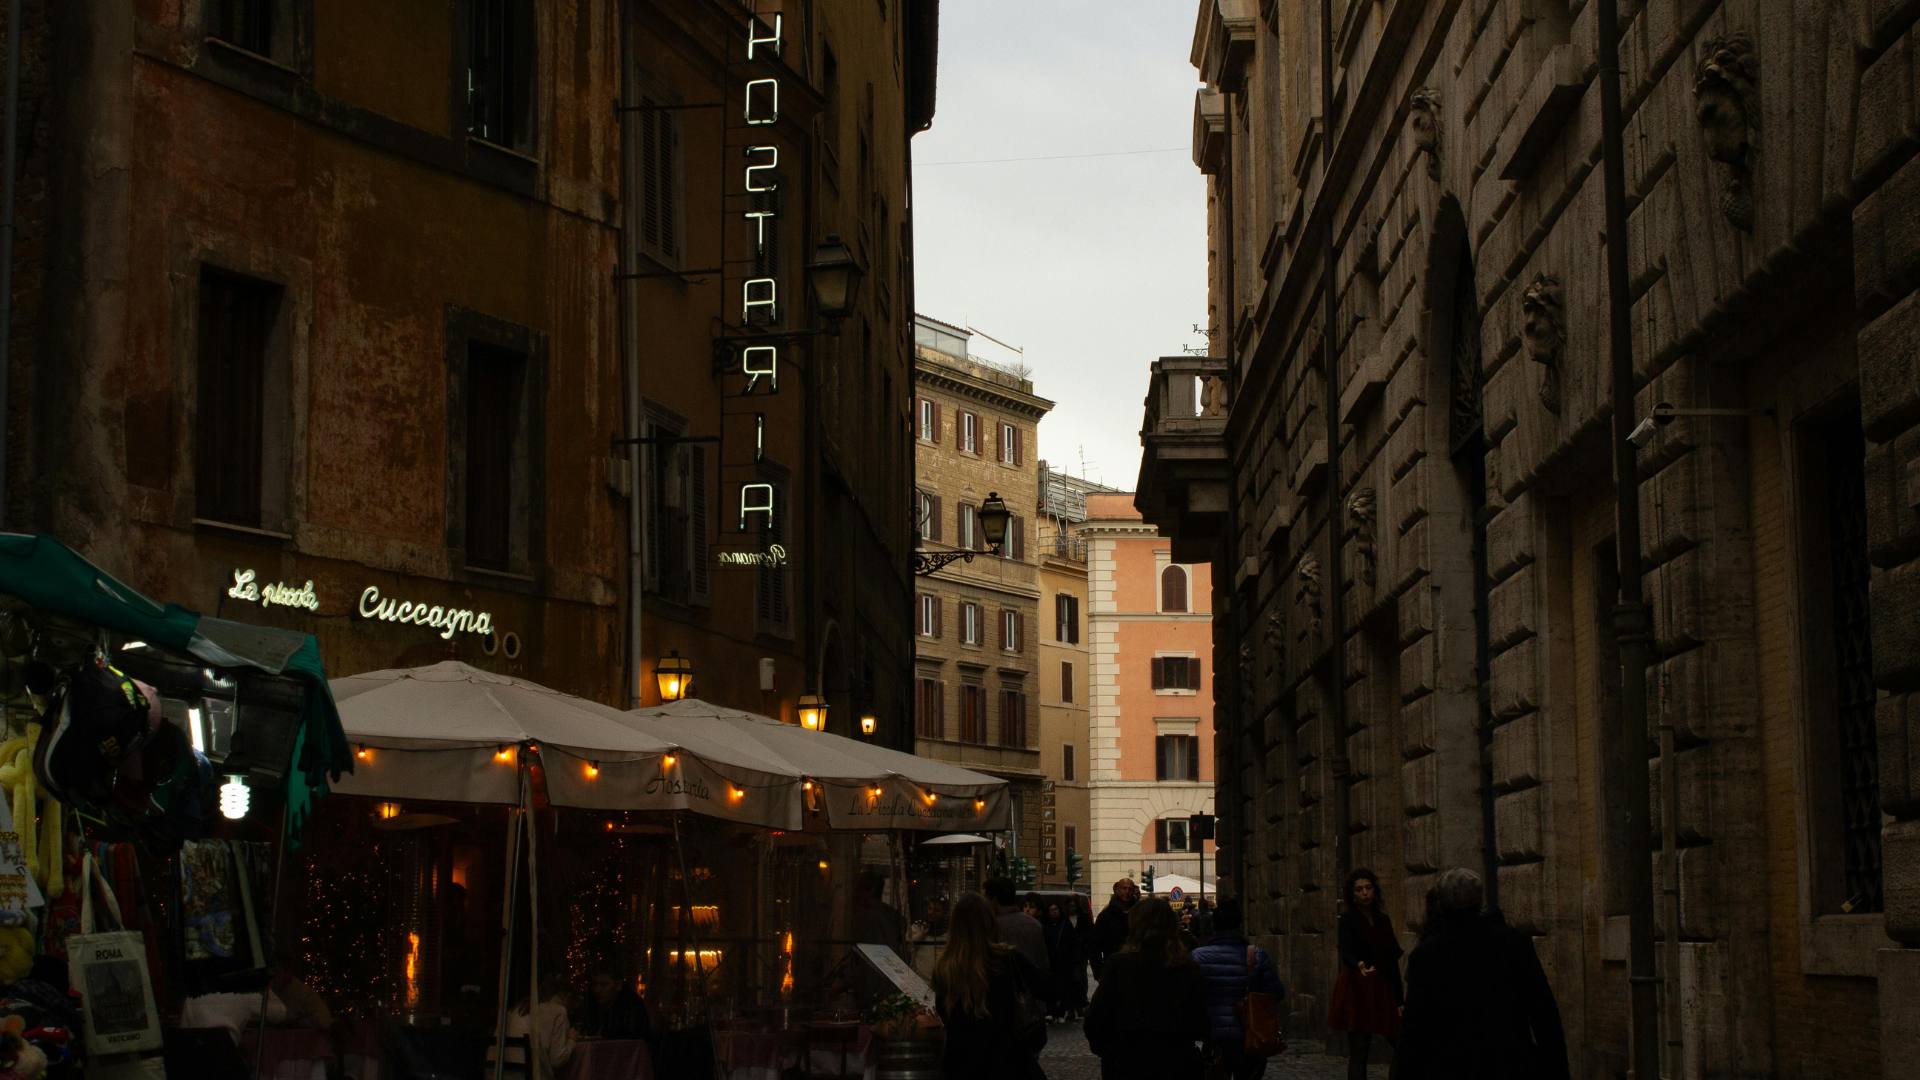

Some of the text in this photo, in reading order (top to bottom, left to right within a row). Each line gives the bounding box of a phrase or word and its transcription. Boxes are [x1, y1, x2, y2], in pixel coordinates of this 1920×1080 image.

[228, 568, 260, 602] La
[359, 585, 495, 640] Cuccagna
[96, 948, 123, 960] ROMA
